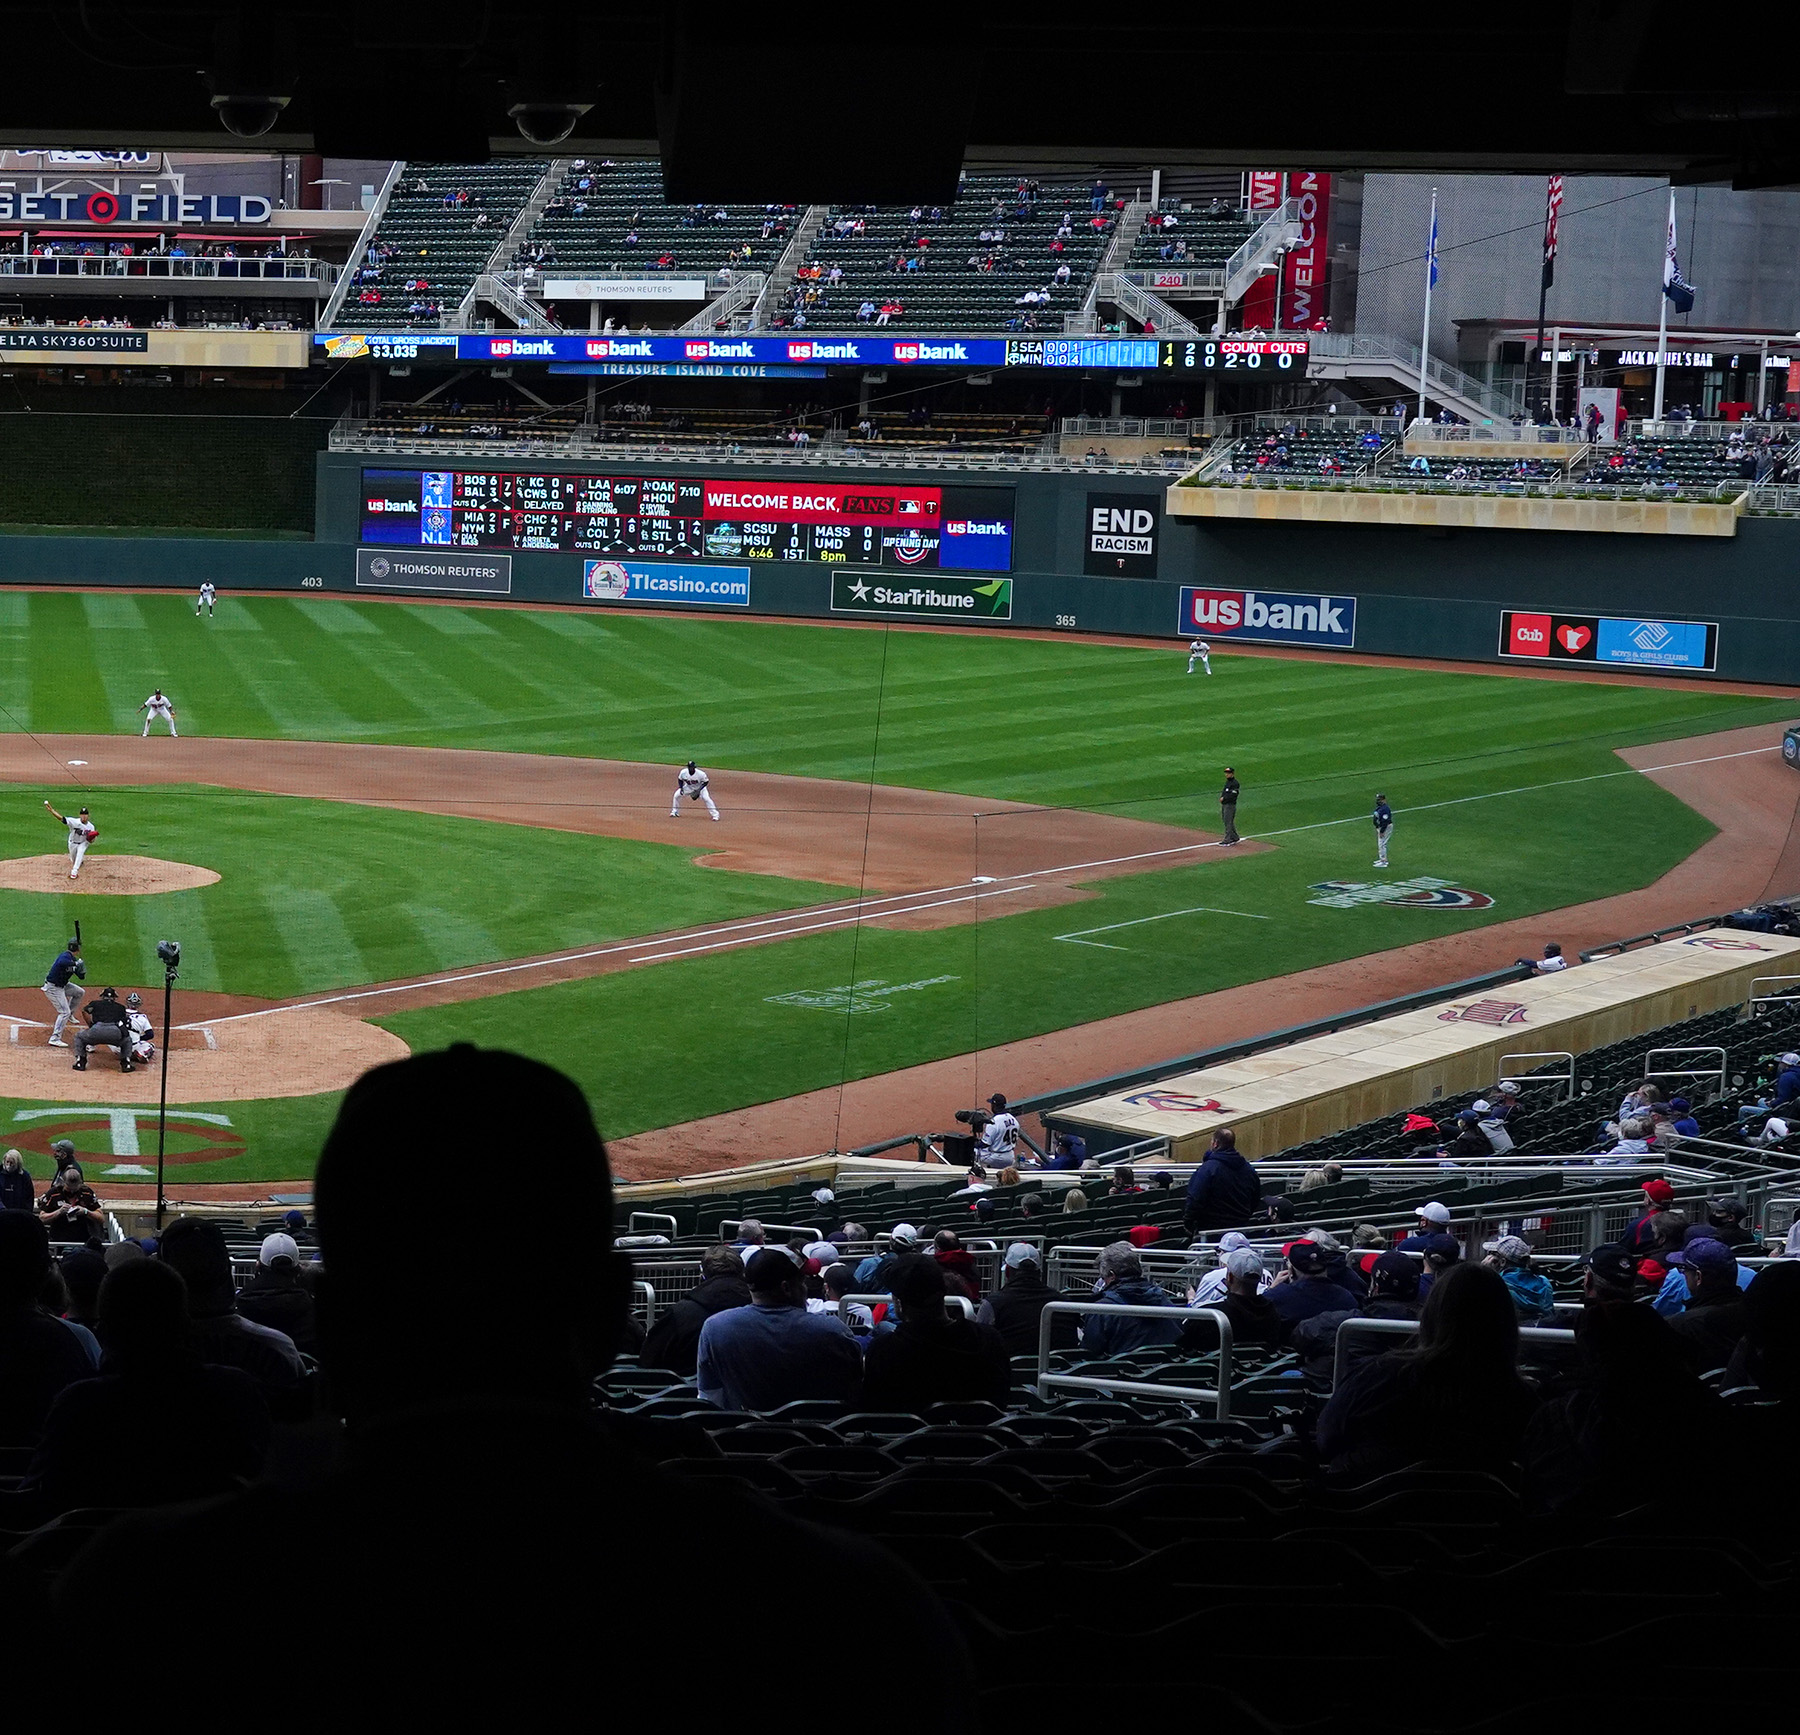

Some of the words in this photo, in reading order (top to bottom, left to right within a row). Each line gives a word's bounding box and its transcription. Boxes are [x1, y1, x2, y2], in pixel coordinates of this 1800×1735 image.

[131, 193, 272, 224] FIELD
[1159, 274, 1181, 287] 240
[596, 285, 635, 294] THOMSON
[637, 286, 673, 295] REUTERS
[102, 337, 142, 348] SUITE
[368, 336, 393, 345] TOTAL
[393, 337, 421, 345] GROSS
[421, 337, 456, 345] JACKPOT
[373, 345, 418, 358] $3,035
[1020, 342, 1043, 352] SEA
[1222, 343, 1268, 353] COUNT
[1271, 343, 1306, 354] OUTS
[1019, 355, 1043, 364] MIN
[1225, 353, 1261, 368] 2-0
[1619, 351, 1645, 364] JACK
[1647, 352, 1692, 366] DAIEL'S
[1693, 353, 1713, 367] BAR
[602, 363, 667, 376] TREASURE
[675, 365, 723, 377] ISLAND
[732, 366, 766, 377] COVE
[464, 476, 486, 485] BOS
[529, 477, 545, 487] KC
[588, 479, 611, 489] LAA
[613, 484, 637, 494] 6:07
[464, 487, 486, 497] BAL
[524, 489, 548, 499] CWS
[651, 481, 676, 491] OAK
[680, 487, 700, 497] 7:10
[422, 495, 451, 508] A.L.
[588, 491, 611, 501] TOR
[651, 493, 676, 503] HOU
[524, 500, 564, 510] DELAYED
[707, 493, 788, 510] WELCOME
[792, 496, 840, 513] BACK,
[845, 497, 893, 513] FANS
[464, 512, 484, 522] MIA
[524, 514, 547, 524] CHC
[589, 517, 608, 527] ARI
[1092, 507, 1153, 534] END
[461, 524, 485, 533] NYM
[526, 526, 545, 535] PIT
[652, 520, 672, 530] MIL
[743, 523, 778, 535] SCSU
[587, 529, 609, 539] COL
[651, 532, 672, 541] STL
[815, 525, 851, 538] MASS
[422, 532, 450, 544] N.L.
[743, 535, 771, 546] MSU
[814, 537, 844, 550] UMD
[883, 536, 920, 548] OPENING
[922, 538, 940, 550] DAY
[1094, 538, 1149, 552] RACISM
[748, 547, 774, 559] 6:46
[783, 549, 805, 560] 1ST
[820, 550, 847, 563] 8pm
[393, 563, 446, 576] THOMSON
[448, 565, 496, 578] REUTERS
[301, 577, 323, 588] 403
[873, 586, 975, 609] StarTribune
[1055, 614, 1076, 627] 365
[1517, 628, 1544, 642] Cub
[1611, 650, 1631, 658] BOYS
[1640, 652, 1662, 660] GIRLS
[1663, 653, 1689, 662] CLUBS
[1002, 1128, 1018, 1146] 46
